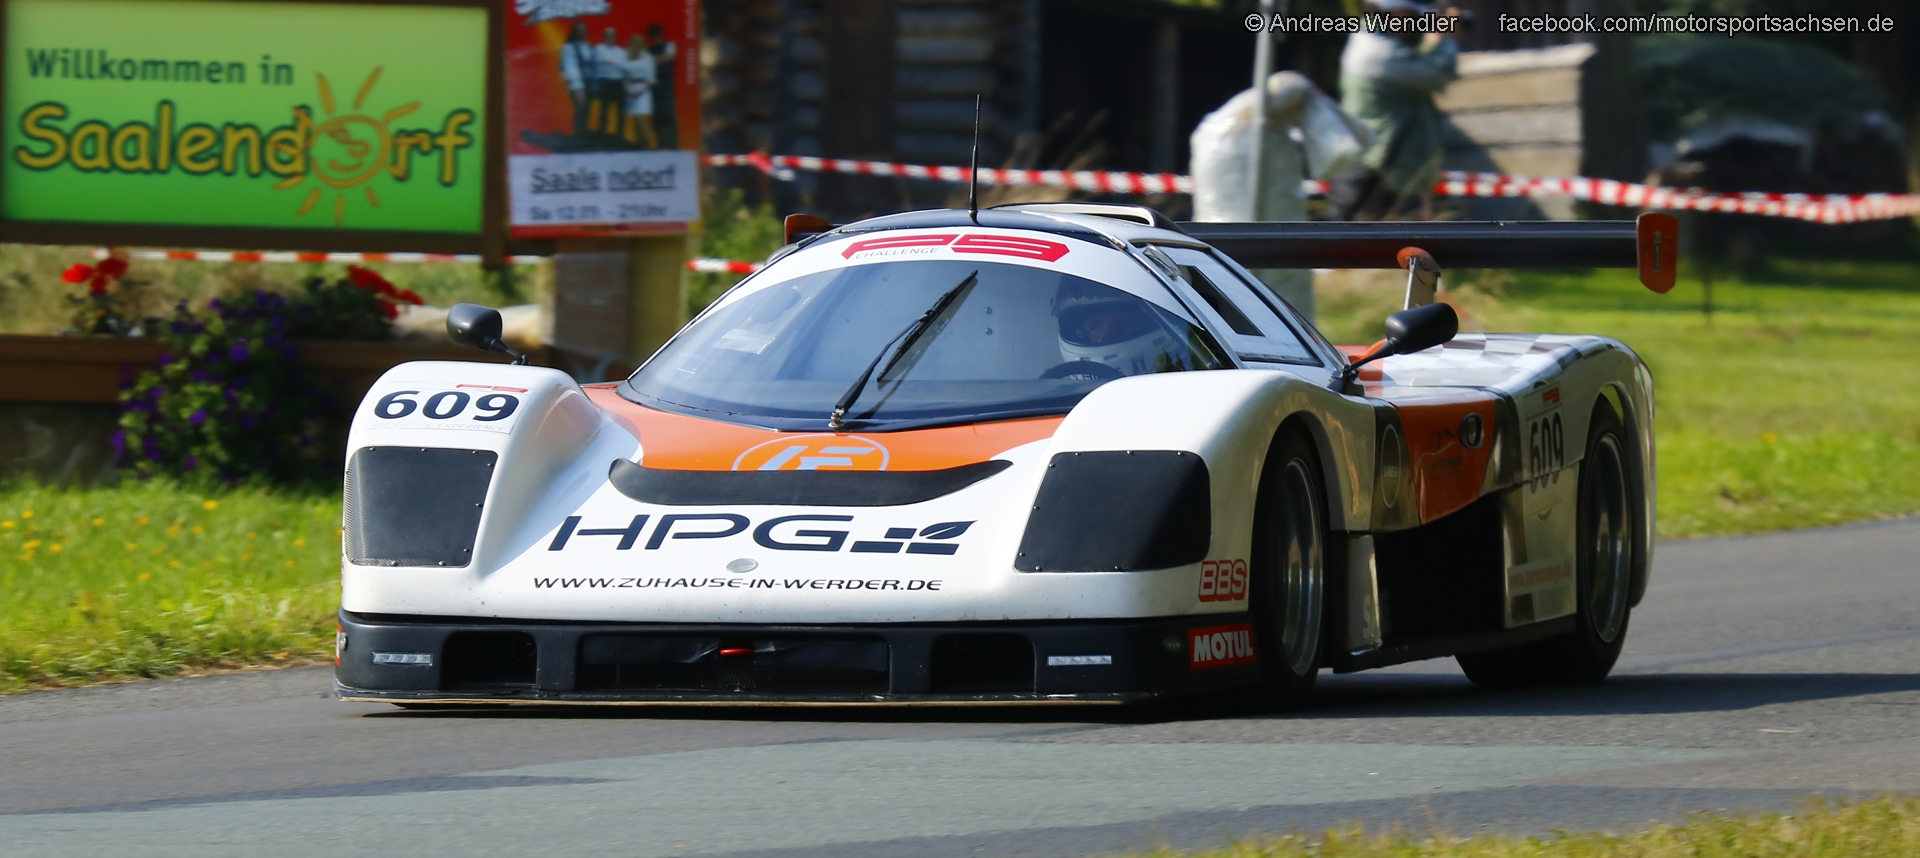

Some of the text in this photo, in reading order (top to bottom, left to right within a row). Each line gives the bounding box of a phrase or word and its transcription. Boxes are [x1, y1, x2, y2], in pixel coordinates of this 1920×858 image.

[26, 47, 295, 86] Willkommen in
[855, 247, 938, 260] CHALLENGE
[373, 390, 520, 422] 609
[1529, 411, 1565, 494] 609
[547, 512, 854, 552] HPG
[533, 576, 943, 592] WWW.ZUHAUSE-IN-WERDER.DE
[1198, 558, 1248, 603] BBS
[1193, 629, 1254, 662] MOTUL
